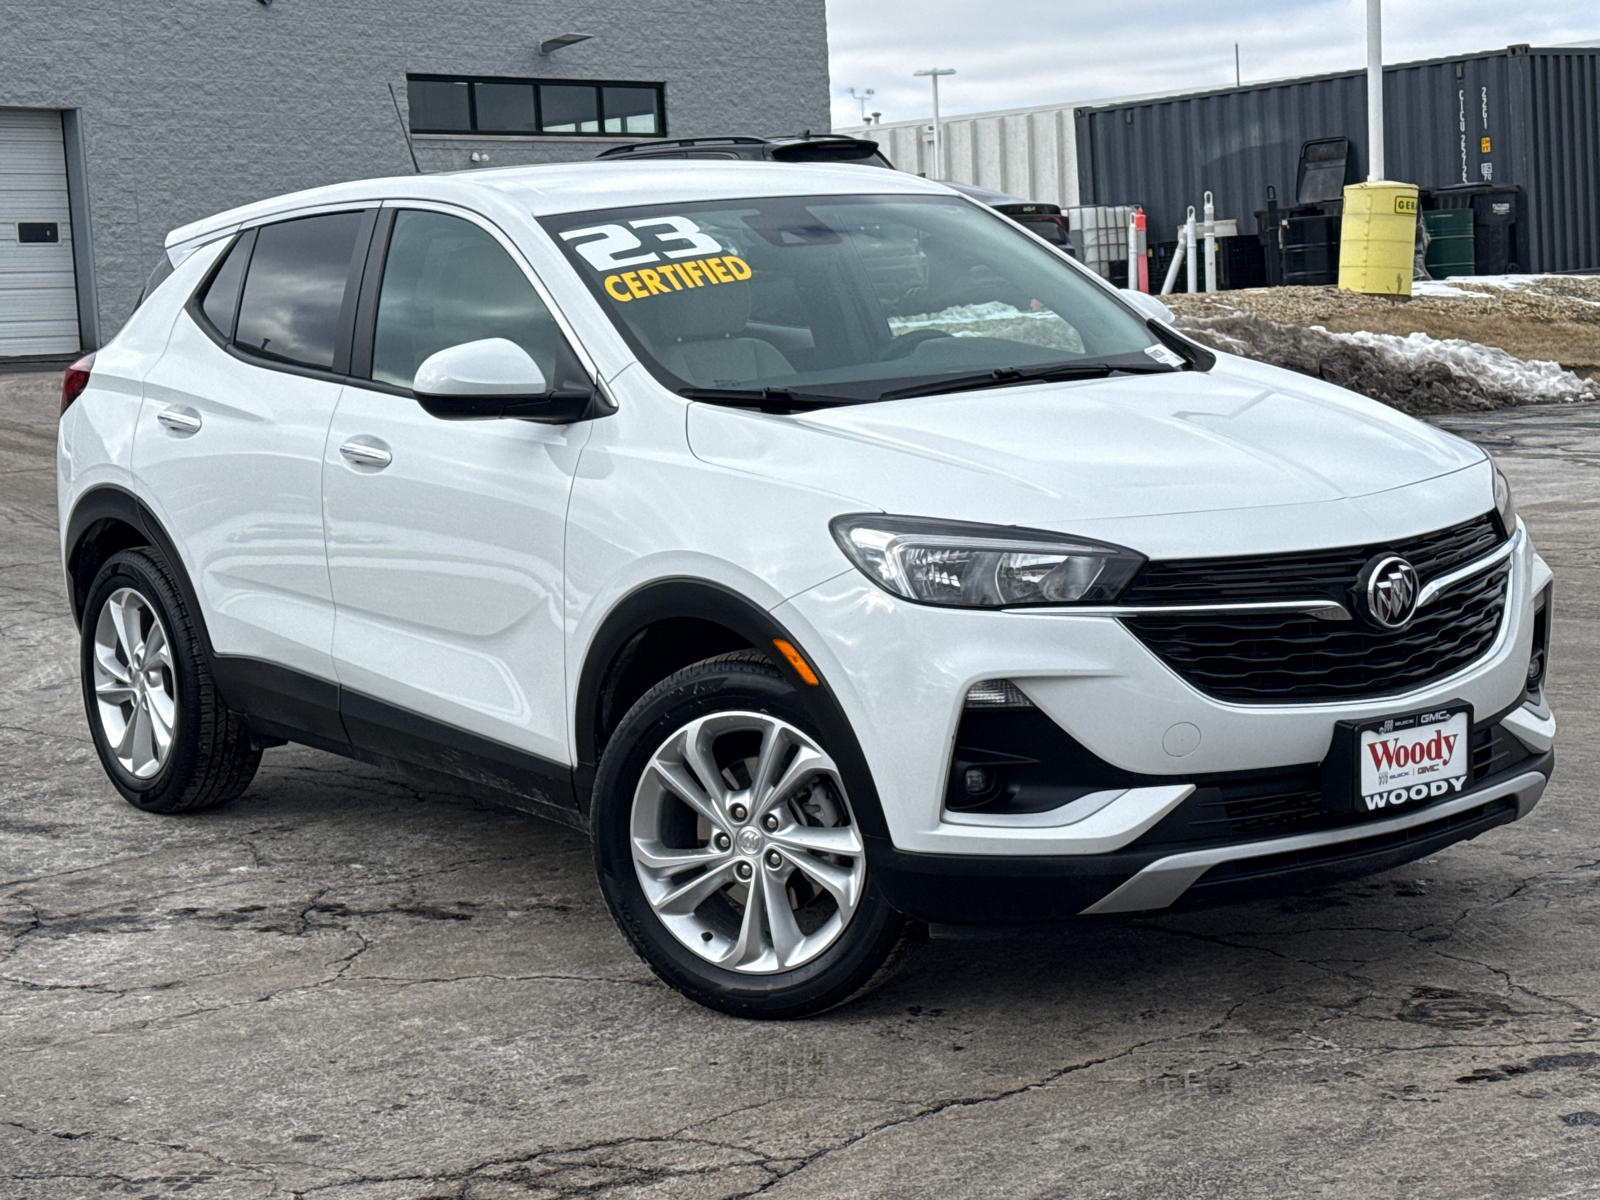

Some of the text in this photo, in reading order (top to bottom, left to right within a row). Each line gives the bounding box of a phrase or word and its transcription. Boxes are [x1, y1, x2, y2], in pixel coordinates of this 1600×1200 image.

[558, 216, 722, 272] 23
[604, 256, 752, 302] CERTIFIED
[1420, 710, 1447, 724] GMC
[1367, 729, 1459, 773] Woody
[1417, 764, 1439, 774] GMC
[1364, 775, 1468, 811] WOODY
